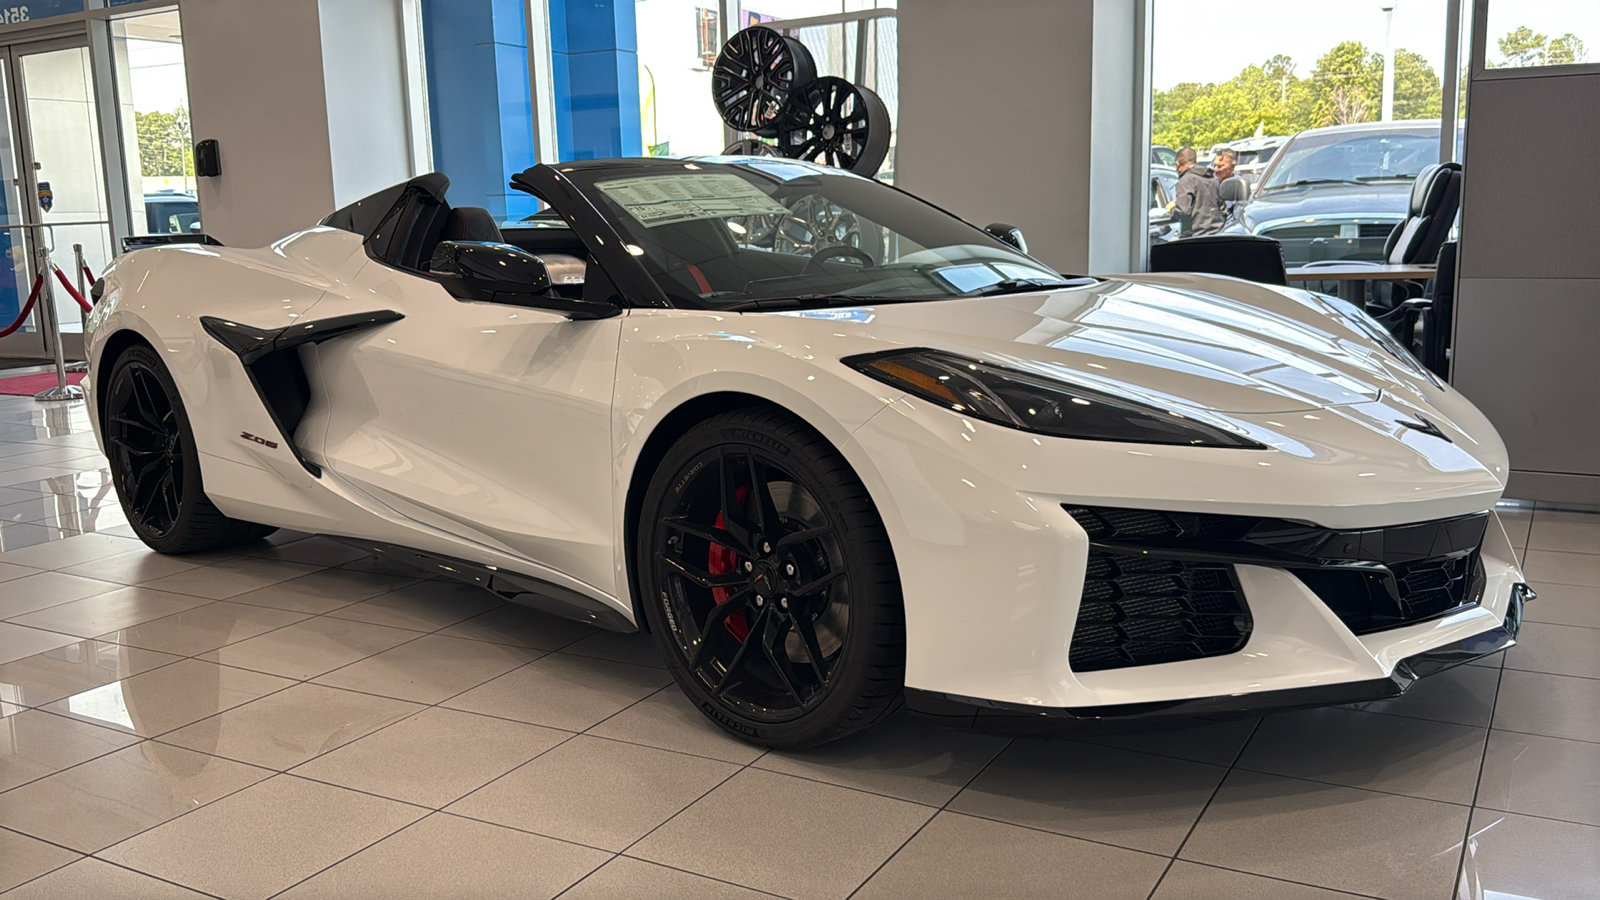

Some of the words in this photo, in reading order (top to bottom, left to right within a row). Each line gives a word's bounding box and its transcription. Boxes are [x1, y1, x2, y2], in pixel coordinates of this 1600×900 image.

[239, 431, 279, 449] Z06
[734, 430, 788, 455] MICHELIN
[674, 461, 703, 493] CORVETTE
[661, 591, 678, 632] FORGED
